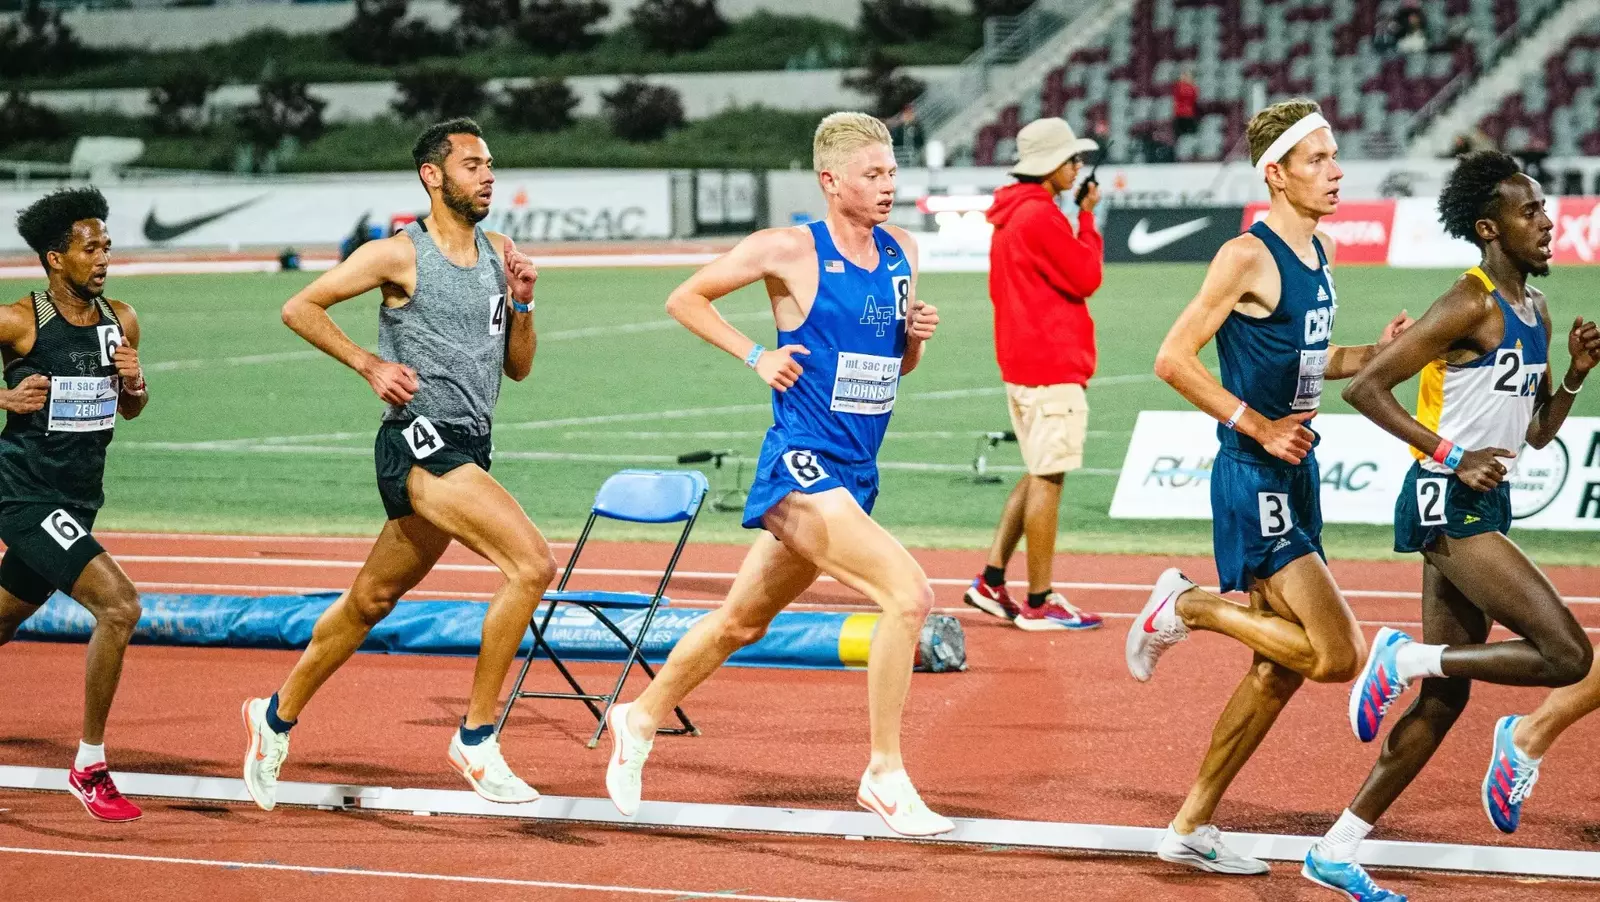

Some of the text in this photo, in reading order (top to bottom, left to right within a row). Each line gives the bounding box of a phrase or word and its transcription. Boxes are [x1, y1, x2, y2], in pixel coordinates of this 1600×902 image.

[492, 297, 505, 332] 4
[898, 279, 909, 317] 8
[860, 295, 895, 337] AF
[104, 327, 118, 364] 6
[862, 360, 880, 371] sac
[1493, 352, 1520, 392] 2
[77, 381, 95, 391] sac
[75, 403, 102, 417] ZERU
[413, 422, 437, 451] 4
[791, 452, 821, 481] 8
[1265, 495, 1286, 534] 3
[1420, 481, 1442, 522] 2
[51, 512, 80, 541] 6
